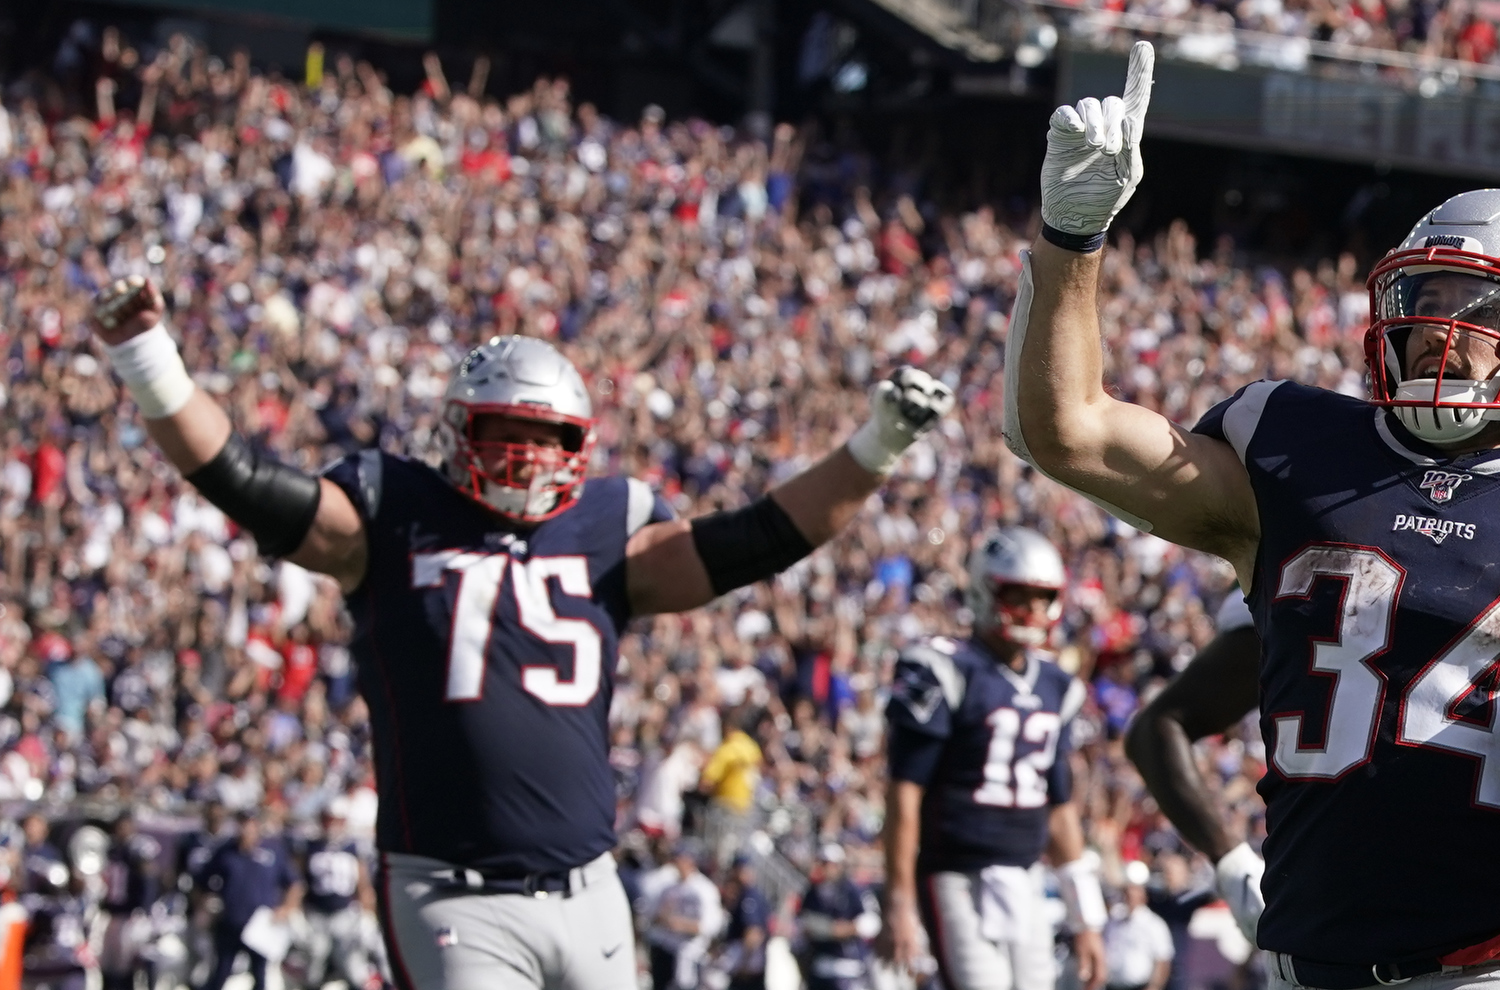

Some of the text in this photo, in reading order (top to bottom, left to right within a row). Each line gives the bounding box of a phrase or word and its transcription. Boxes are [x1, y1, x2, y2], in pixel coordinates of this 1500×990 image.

[1392, 514, 1476, 540] PATRIOTS
[410, 547, 602, 707] 75
[972, 706, 1061, 808] 12
